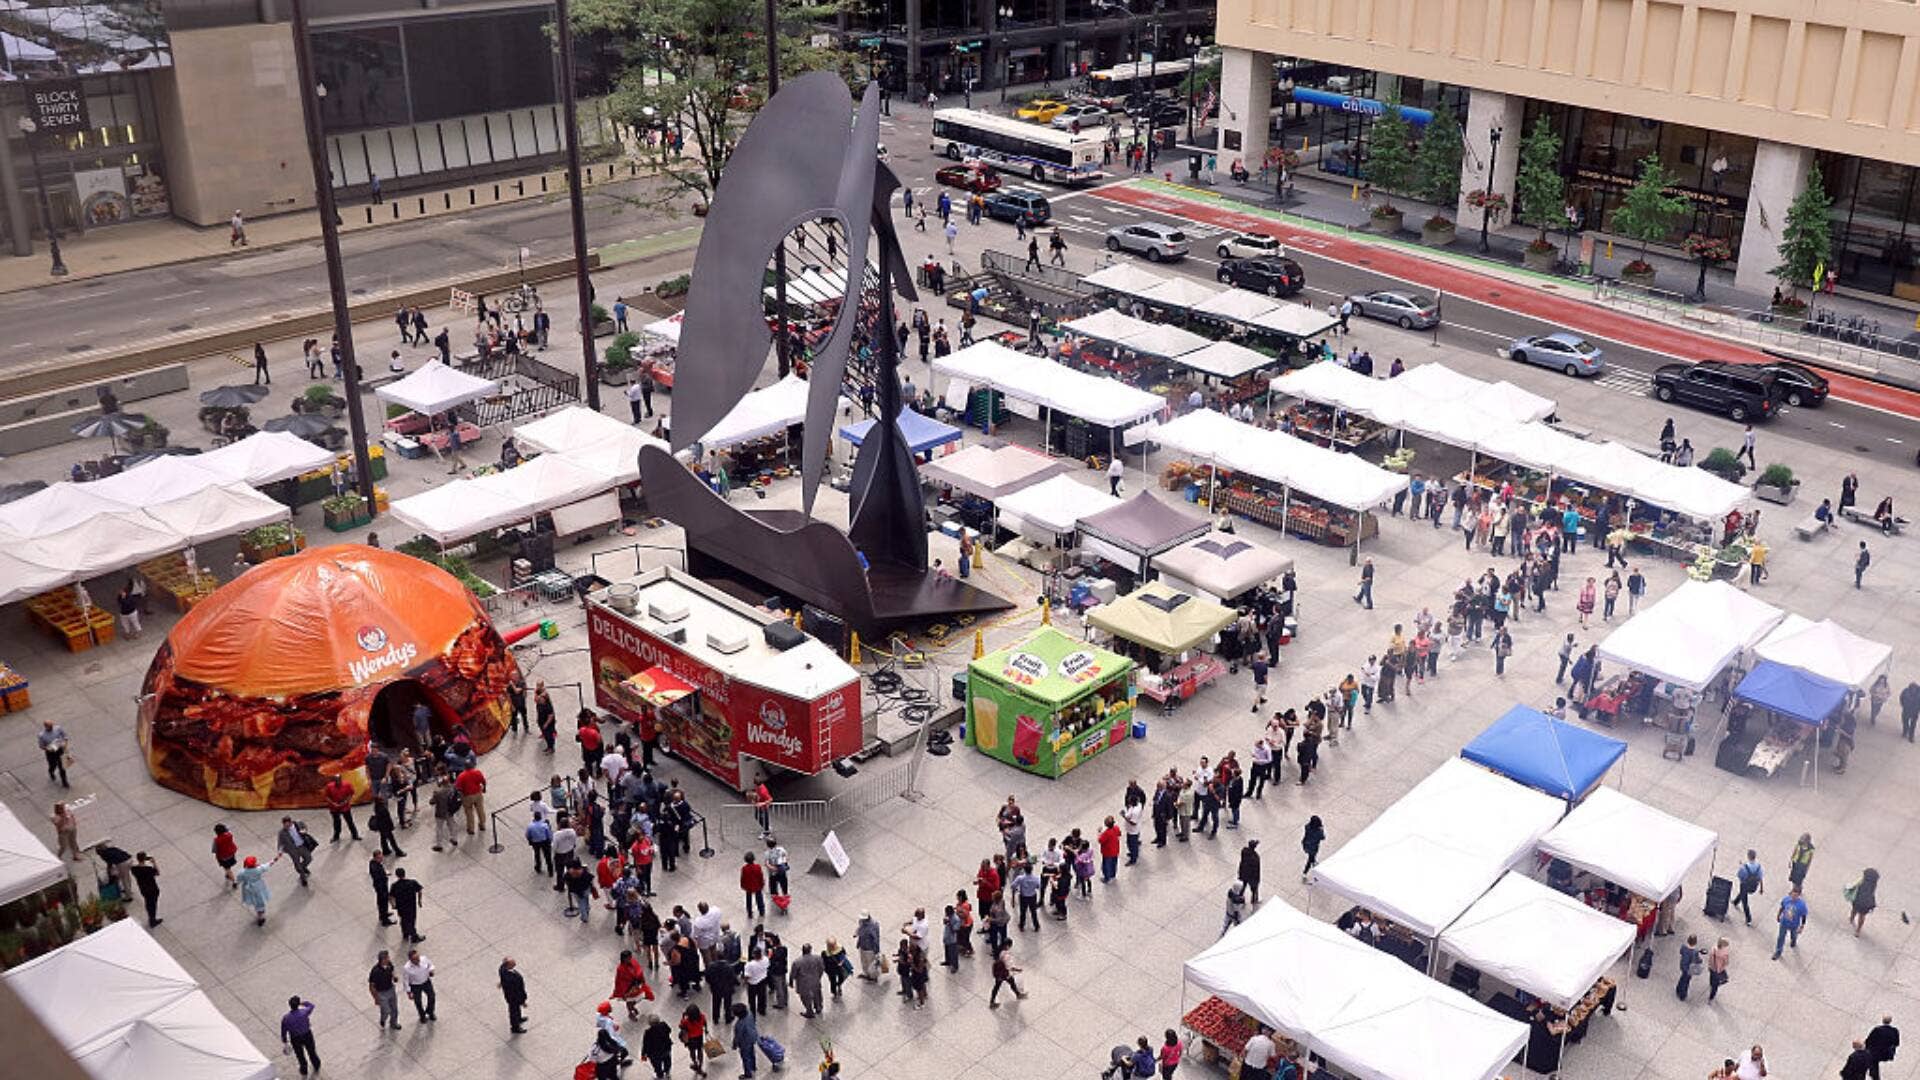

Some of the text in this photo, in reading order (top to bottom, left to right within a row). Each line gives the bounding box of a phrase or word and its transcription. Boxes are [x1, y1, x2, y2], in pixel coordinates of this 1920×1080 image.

[35, 90, 78, 104] BLOCK
[40, 101, 80, 115] THIRTY
[41, 114, 80, 127] SEVEN
[592, 614, 672, 669] DELICIOUS
[348, 642, 417, 683] Wendy's
[747, 721, 803, 756] Wendy's
